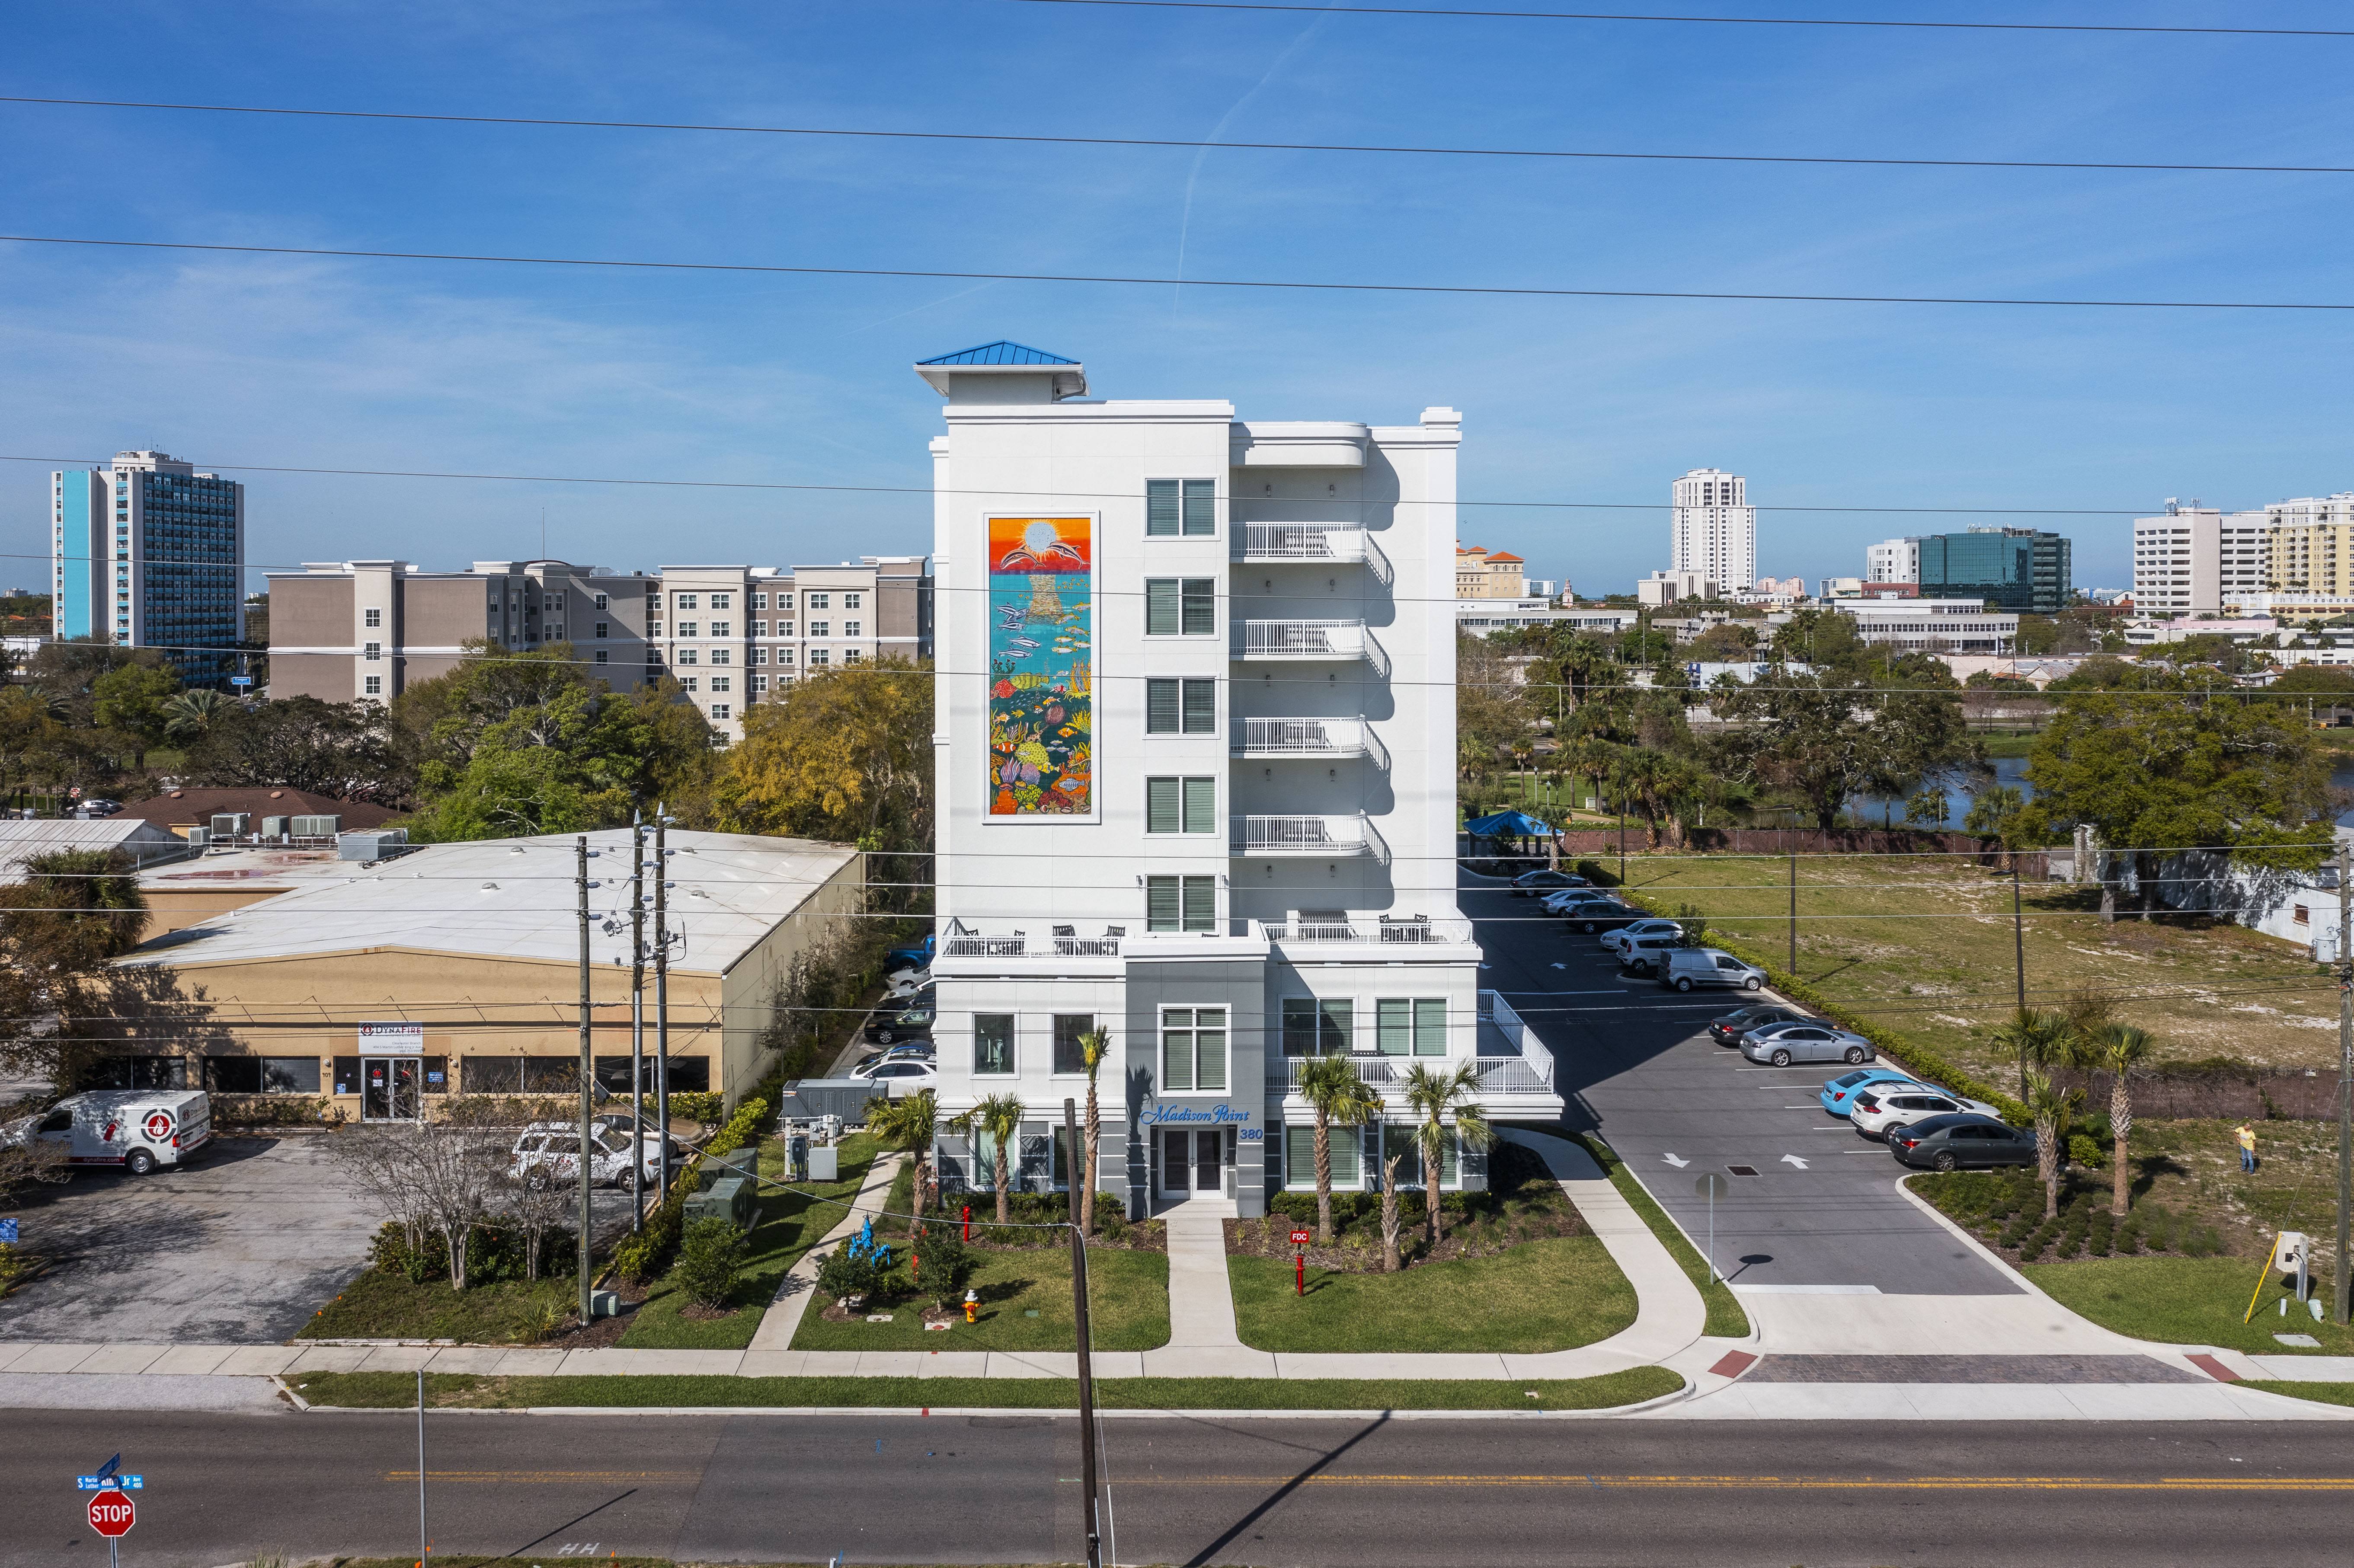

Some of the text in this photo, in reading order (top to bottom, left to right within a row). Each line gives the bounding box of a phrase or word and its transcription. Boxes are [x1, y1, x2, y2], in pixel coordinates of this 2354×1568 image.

[1140, 1104, 1250, 1124] Madison Point
[1240, 1129, 1263, 1139] 380
[77, 1478, 83, 1488] S
[122, 1476, 130, 1486] Jr
[92, 1505, 131, 1523] STOP
